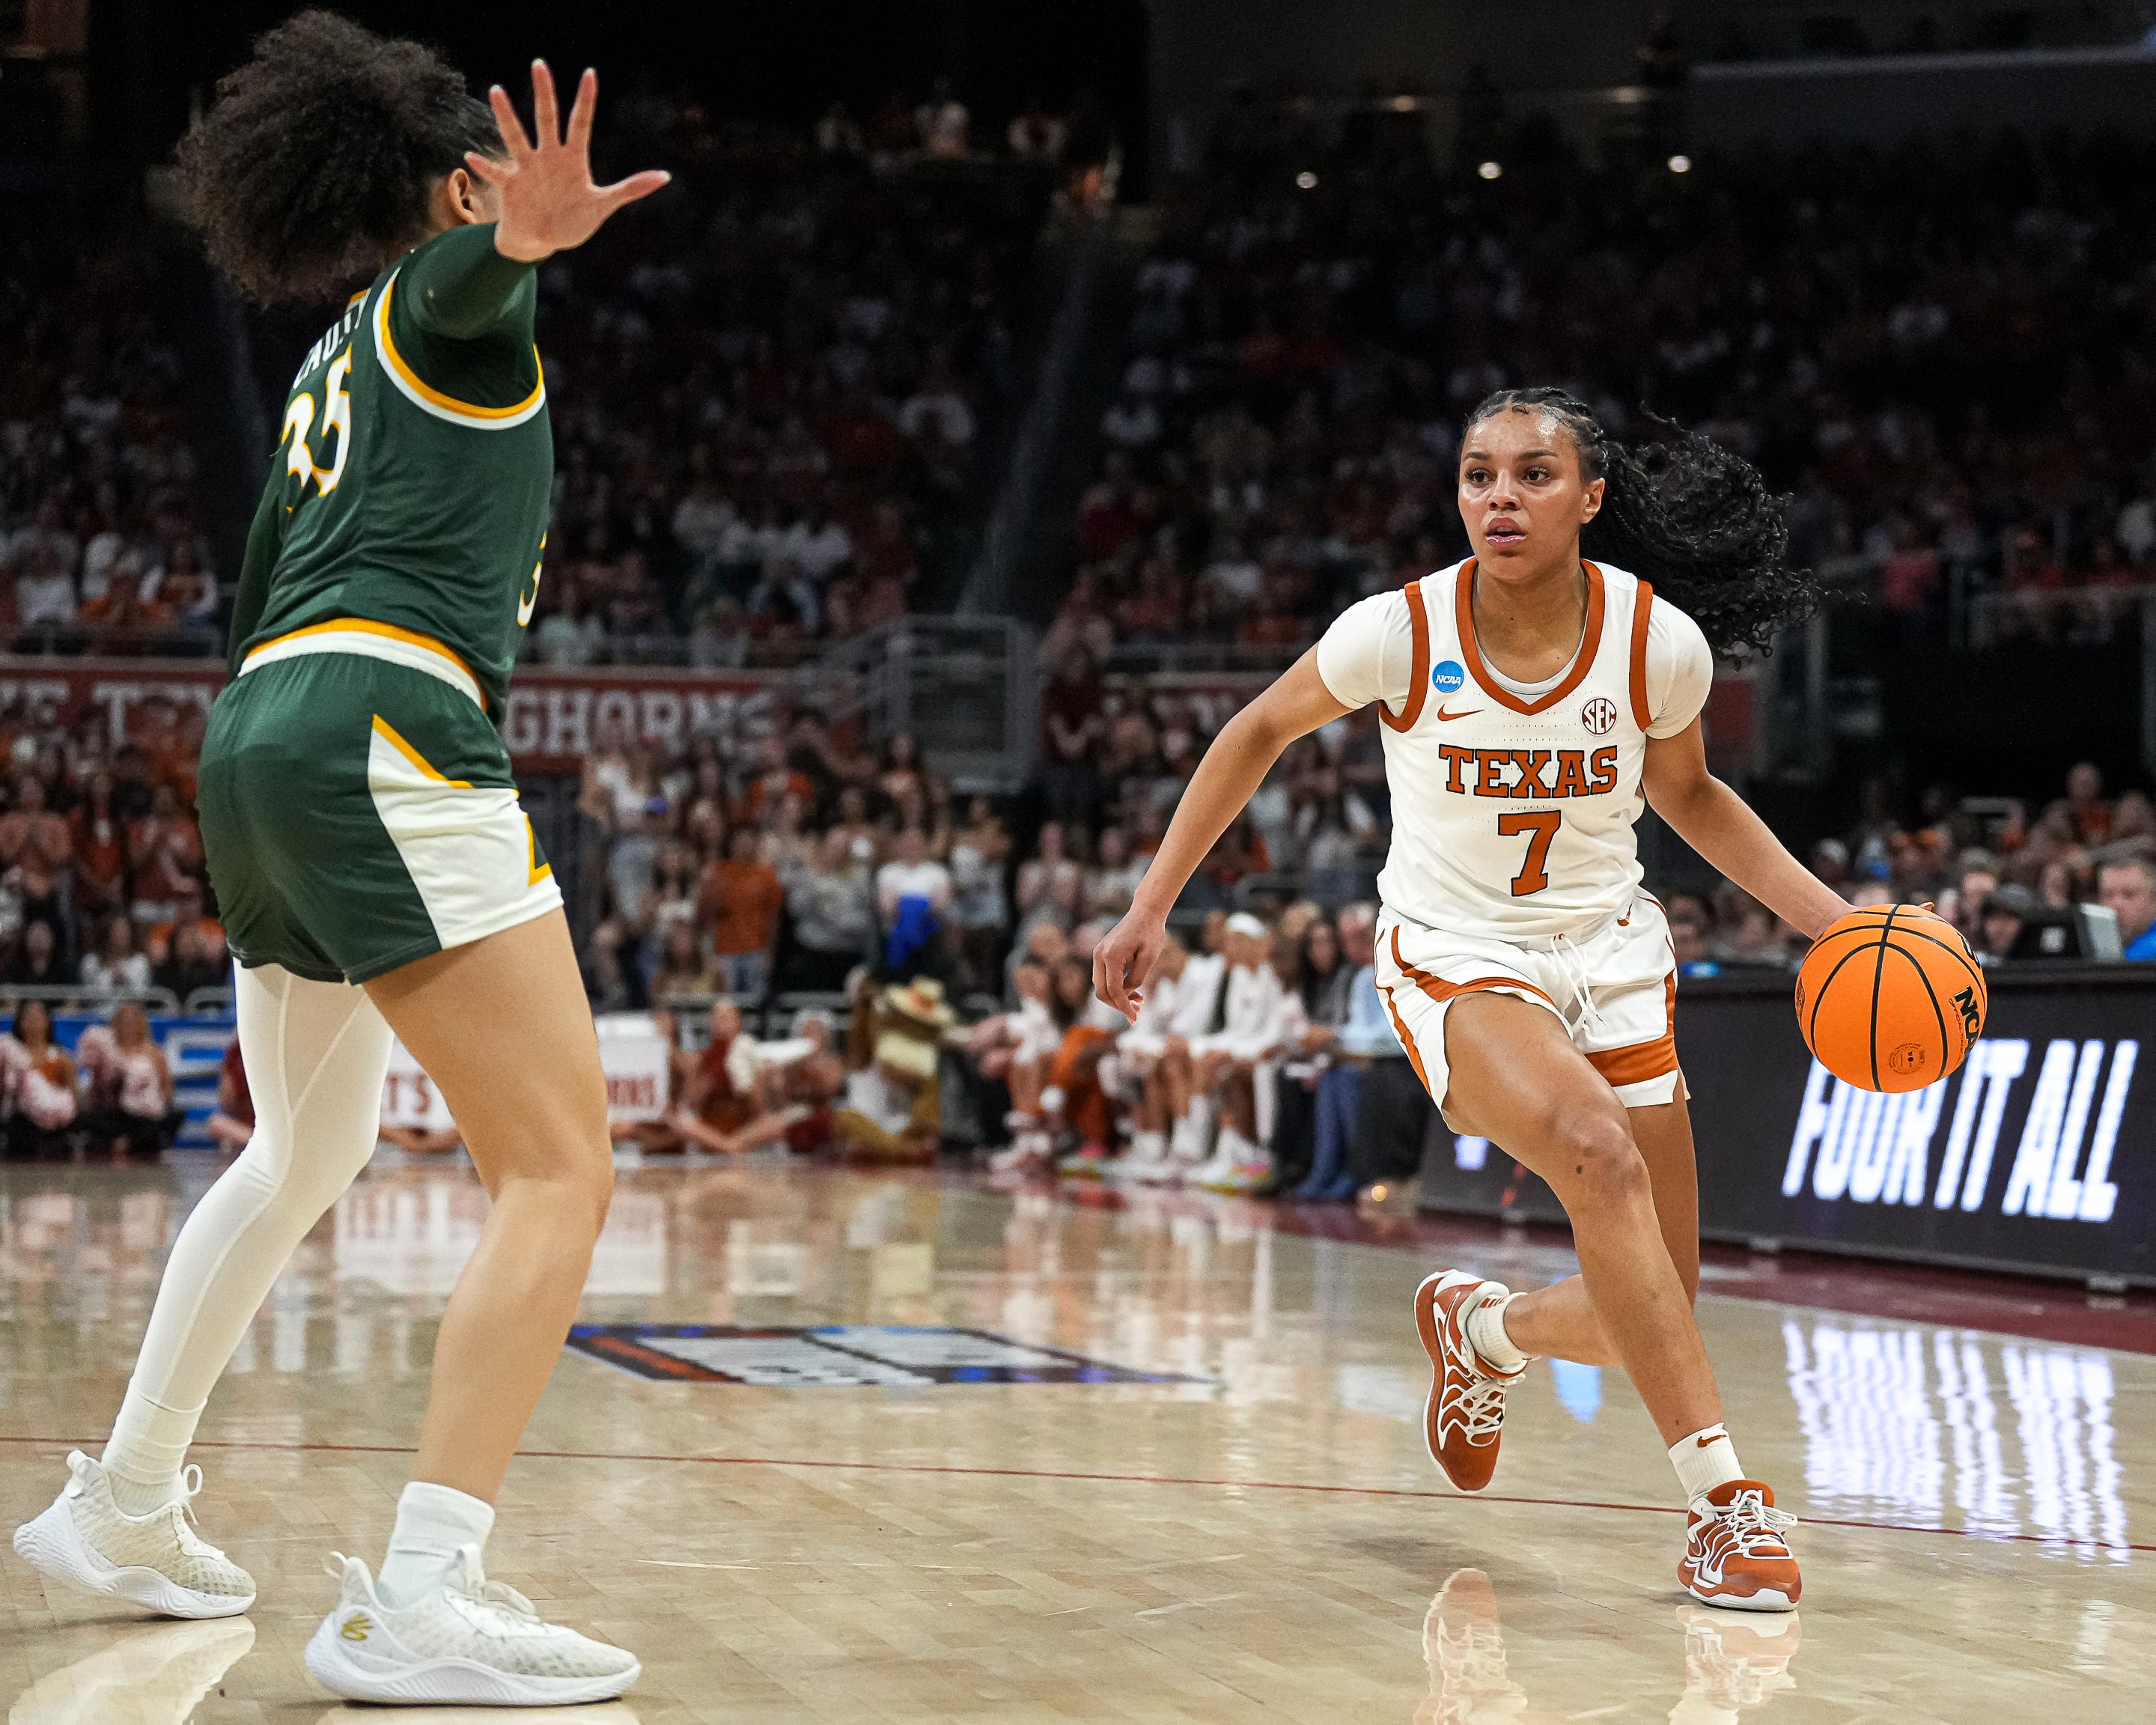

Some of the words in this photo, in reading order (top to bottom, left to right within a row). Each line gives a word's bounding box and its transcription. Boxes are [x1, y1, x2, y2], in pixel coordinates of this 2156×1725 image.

[281, 341, 353, 514] 35
[1436, 674, 1461, 685] NCAA
[1583, 698, 1617, 734] SEC
[1439, 743, 1618, 799] TEXAS
[1497, 809, 1562, 897] 7
[1935, 1039, 2029, 1210] IT
[2002, 1038, 2139, 1222] ALL
